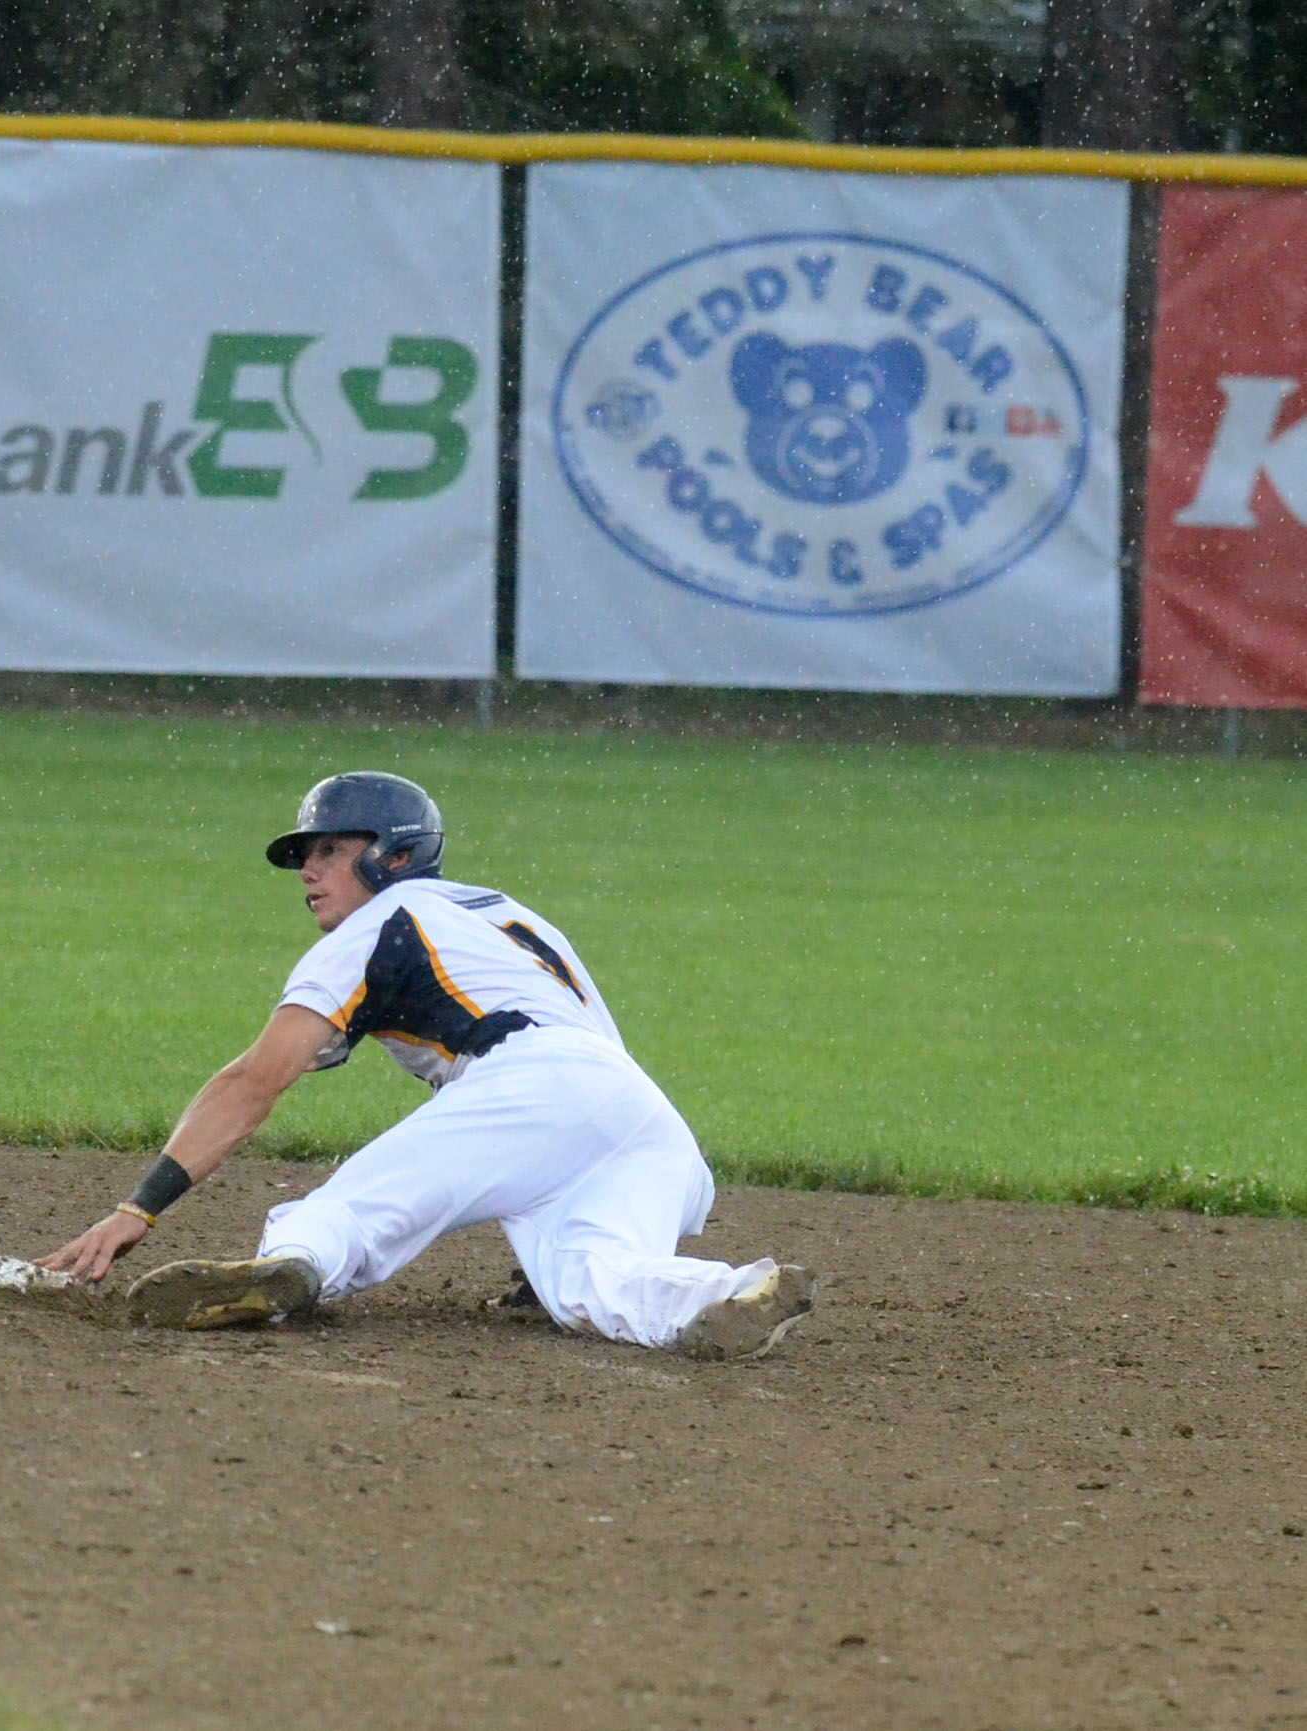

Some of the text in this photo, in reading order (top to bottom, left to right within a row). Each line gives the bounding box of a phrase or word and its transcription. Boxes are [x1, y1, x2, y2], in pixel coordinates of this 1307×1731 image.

[633, 254, 1013, 394] TEDDY BEAR
[637, 434, 808, 580] POOLS
[882, 447, 1012, 569] SPAS
[391, 824, 422, 833] EASTON
